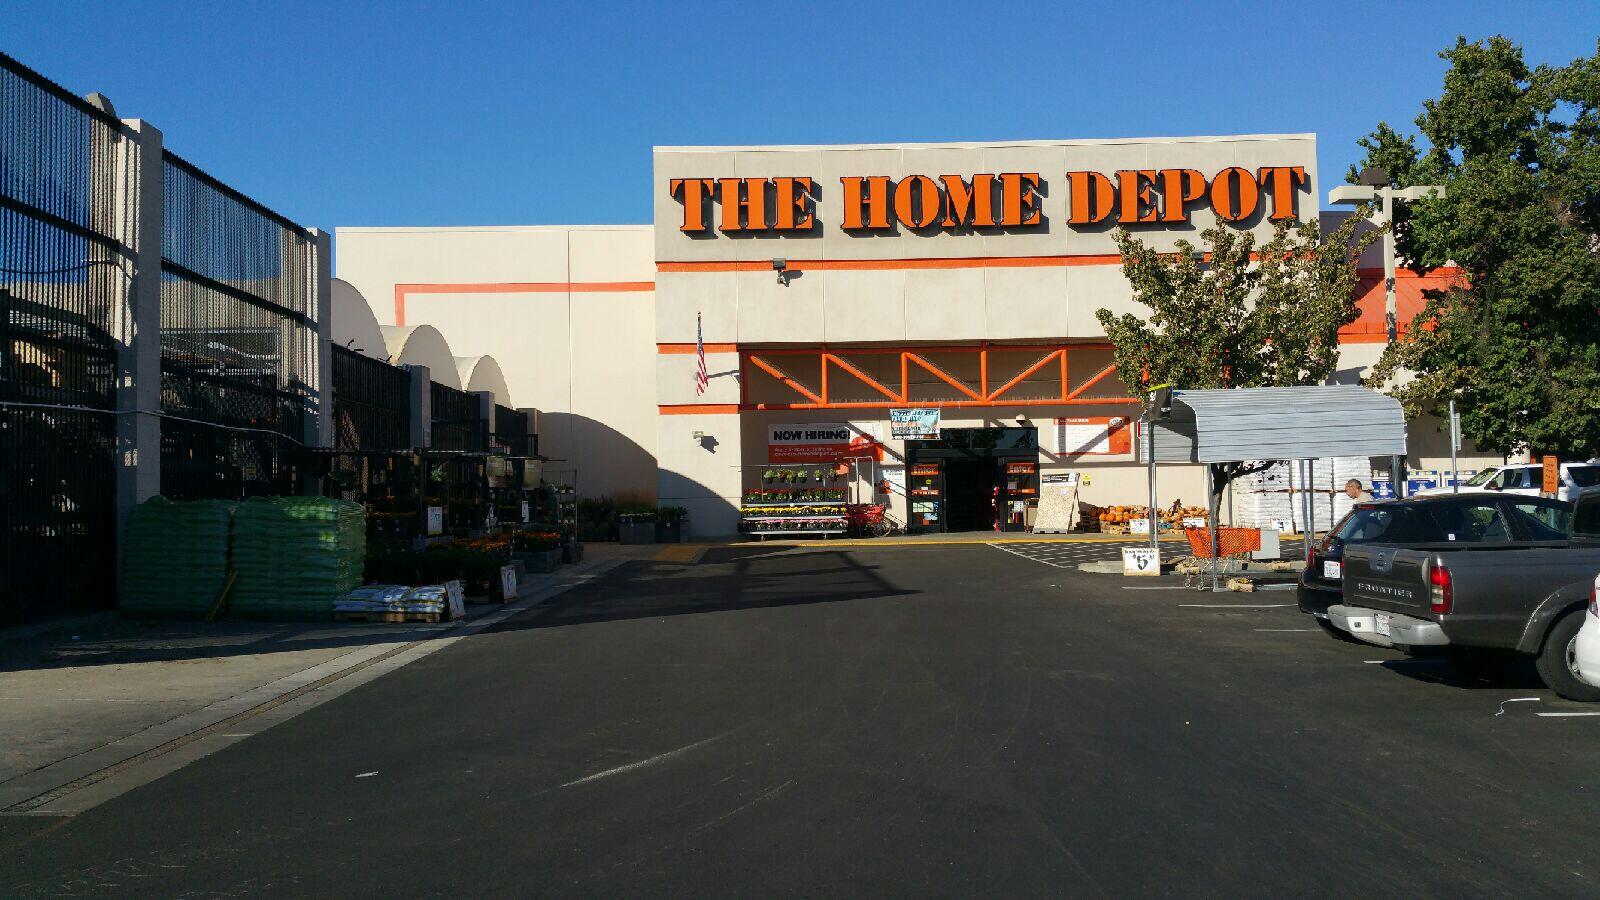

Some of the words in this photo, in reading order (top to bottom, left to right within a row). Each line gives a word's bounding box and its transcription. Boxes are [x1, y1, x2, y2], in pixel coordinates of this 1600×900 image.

[670, 177, 815, 233] THE
[840, 172, 1042, 230] HOME
[1065, 166, 1306, 227] DEPOT
[773, 430, 803, 441] NOW
[804, 429, 851, 440] HIRING!
[1358, 582, 1413, 598] FRONTIER
